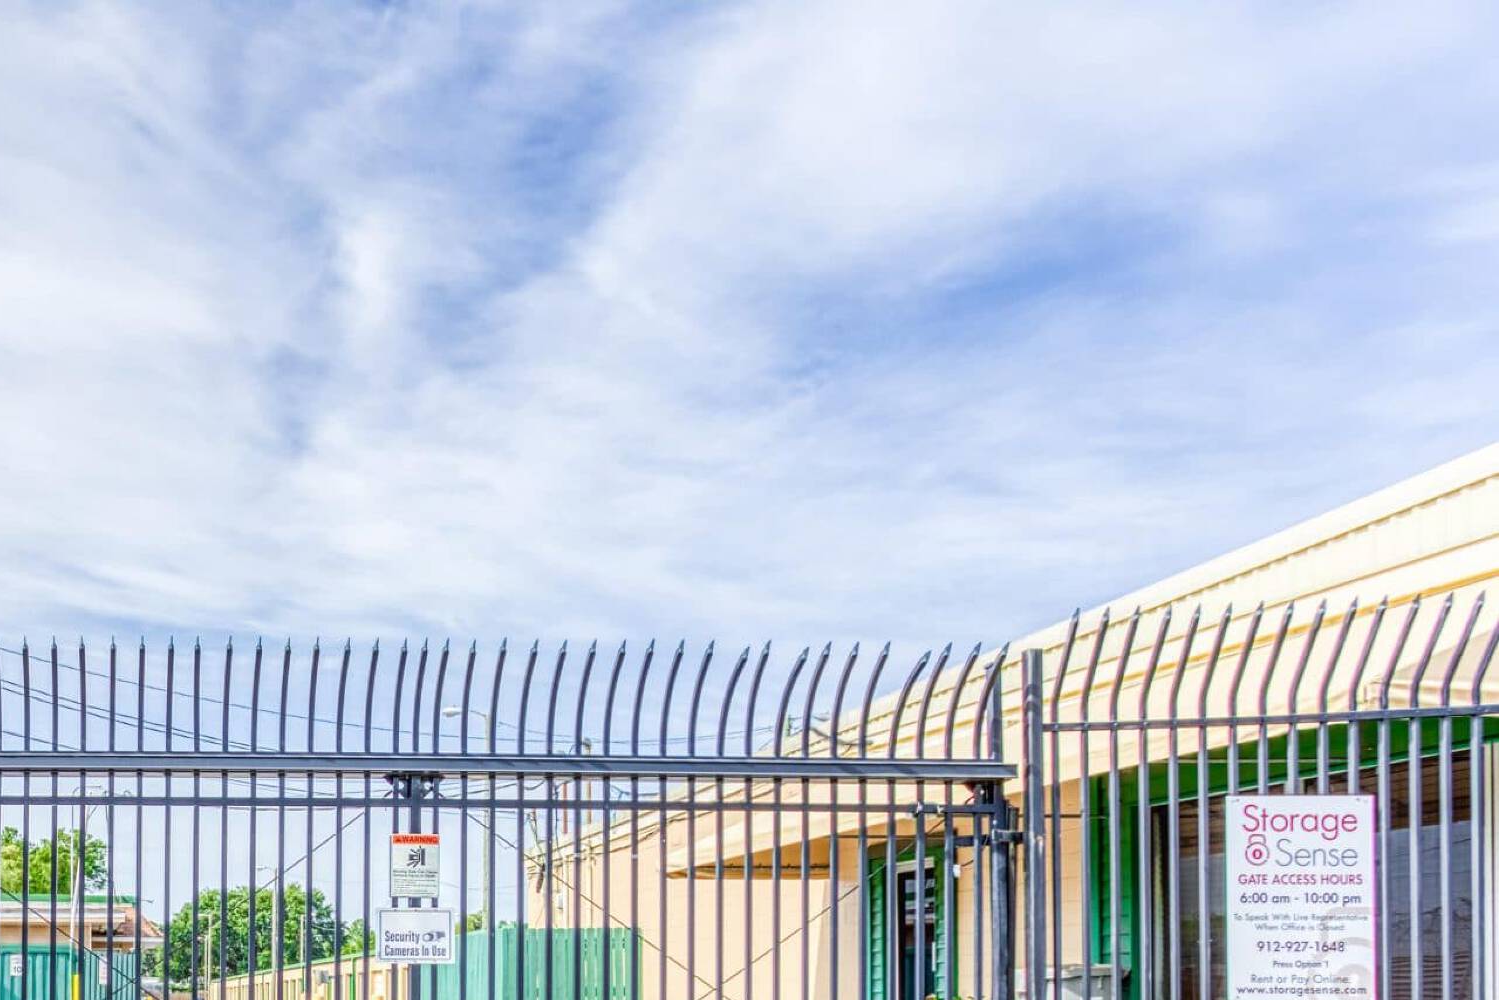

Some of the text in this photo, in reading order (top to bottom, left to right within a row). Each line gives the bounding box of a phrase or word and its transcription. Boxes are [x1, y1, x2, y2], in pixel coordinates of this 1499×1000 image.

[1242, 804, 1358, 841] Storage
[402, 835, 438, 844] WARNING
[1275, 838, 1358, 867] Sense
[1238, 874, 1363, 885] GATE ACCESS HOURS
[1240, 892, 1268, 903] 6:00
[1272, 894, 1290, 903] am
[1304, 892, 1339, 903] 10:00
[1342, 894, 1362, 907] pm
[385, 930, 420, 945] Security
[385, 944, 447, 957] Cameras In Use
[1257, 941, 1345, 952] 912-927-1648
[1251, 975, 1273, 983] Rent
[1291, 975, 1310, 985] Pay
[1237, 986, 1367, 997] www.storagesense.com
